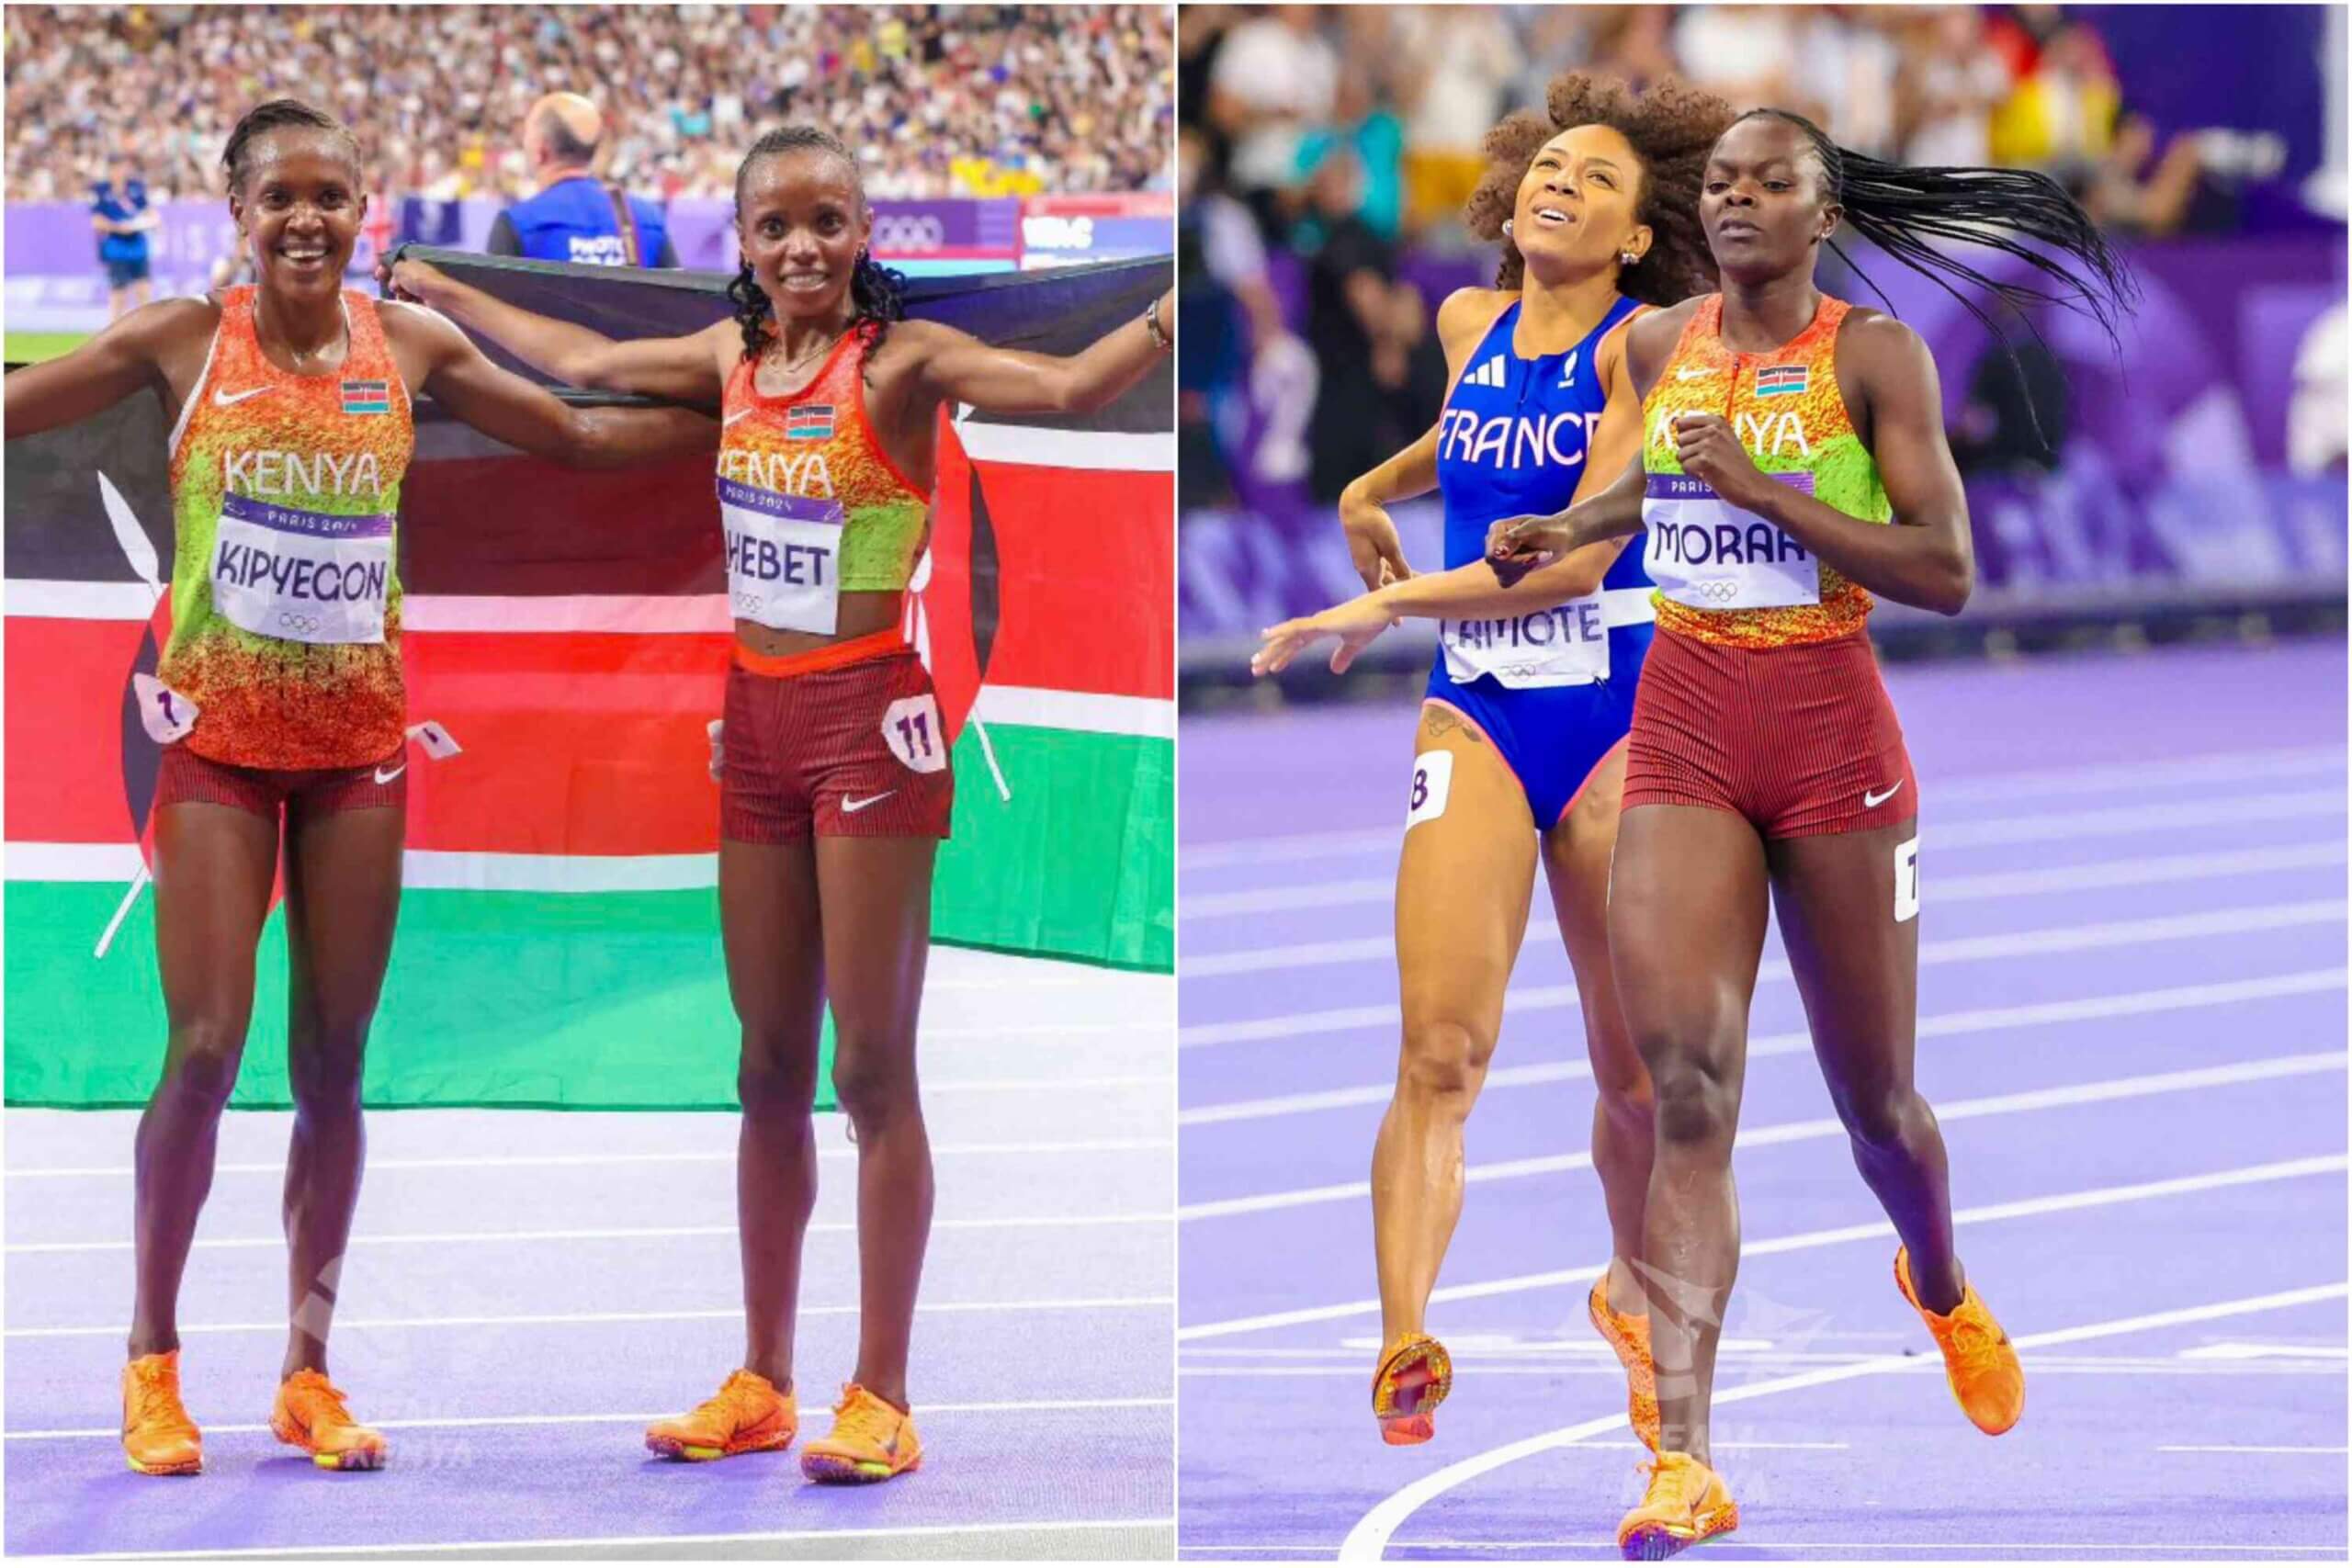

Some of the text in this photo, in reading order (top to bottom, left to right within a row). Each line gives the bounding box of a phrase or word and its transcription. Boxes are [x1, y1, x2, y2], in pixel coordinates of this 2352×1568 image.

[1652, 406, 1811, 457] KYA
[224, 449, 380, 499] KENYA
[1671, 479, 1713, 494] PARIS
[267, 510, 315, 530] PARIS
[216, 539, 387, 602] KIPYEGON
[896, 710, 933, 760] 11
